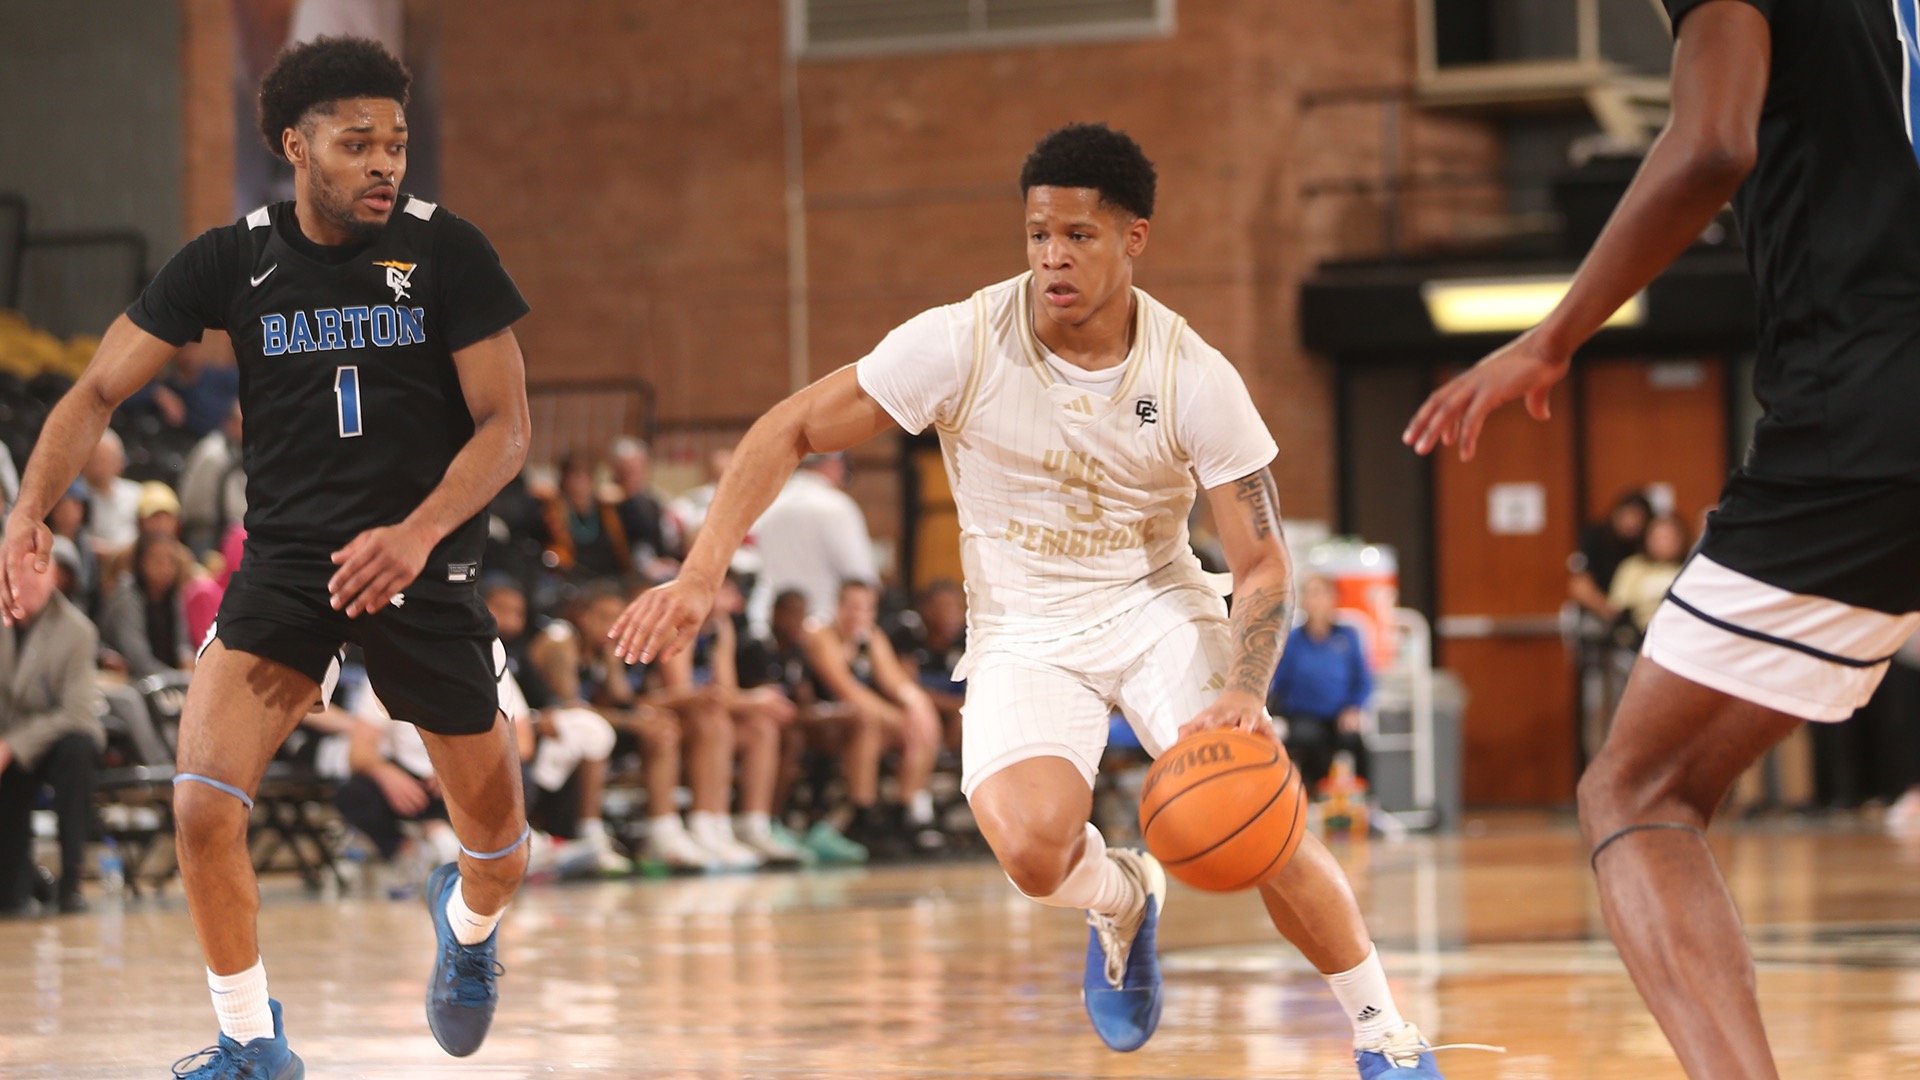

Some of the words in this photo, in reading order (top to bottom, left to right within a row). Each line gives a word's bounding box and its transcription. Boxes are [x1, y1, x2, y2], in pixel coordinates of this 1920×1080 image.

[261, 304, 426, 357] BARTON
[333, 364, 363, 438] 1
[1042, 449, 1105, 484] UNC
[1060, 478, 1104, 524] 3
[1004, 515, 1158, 558] PEMBROKE
